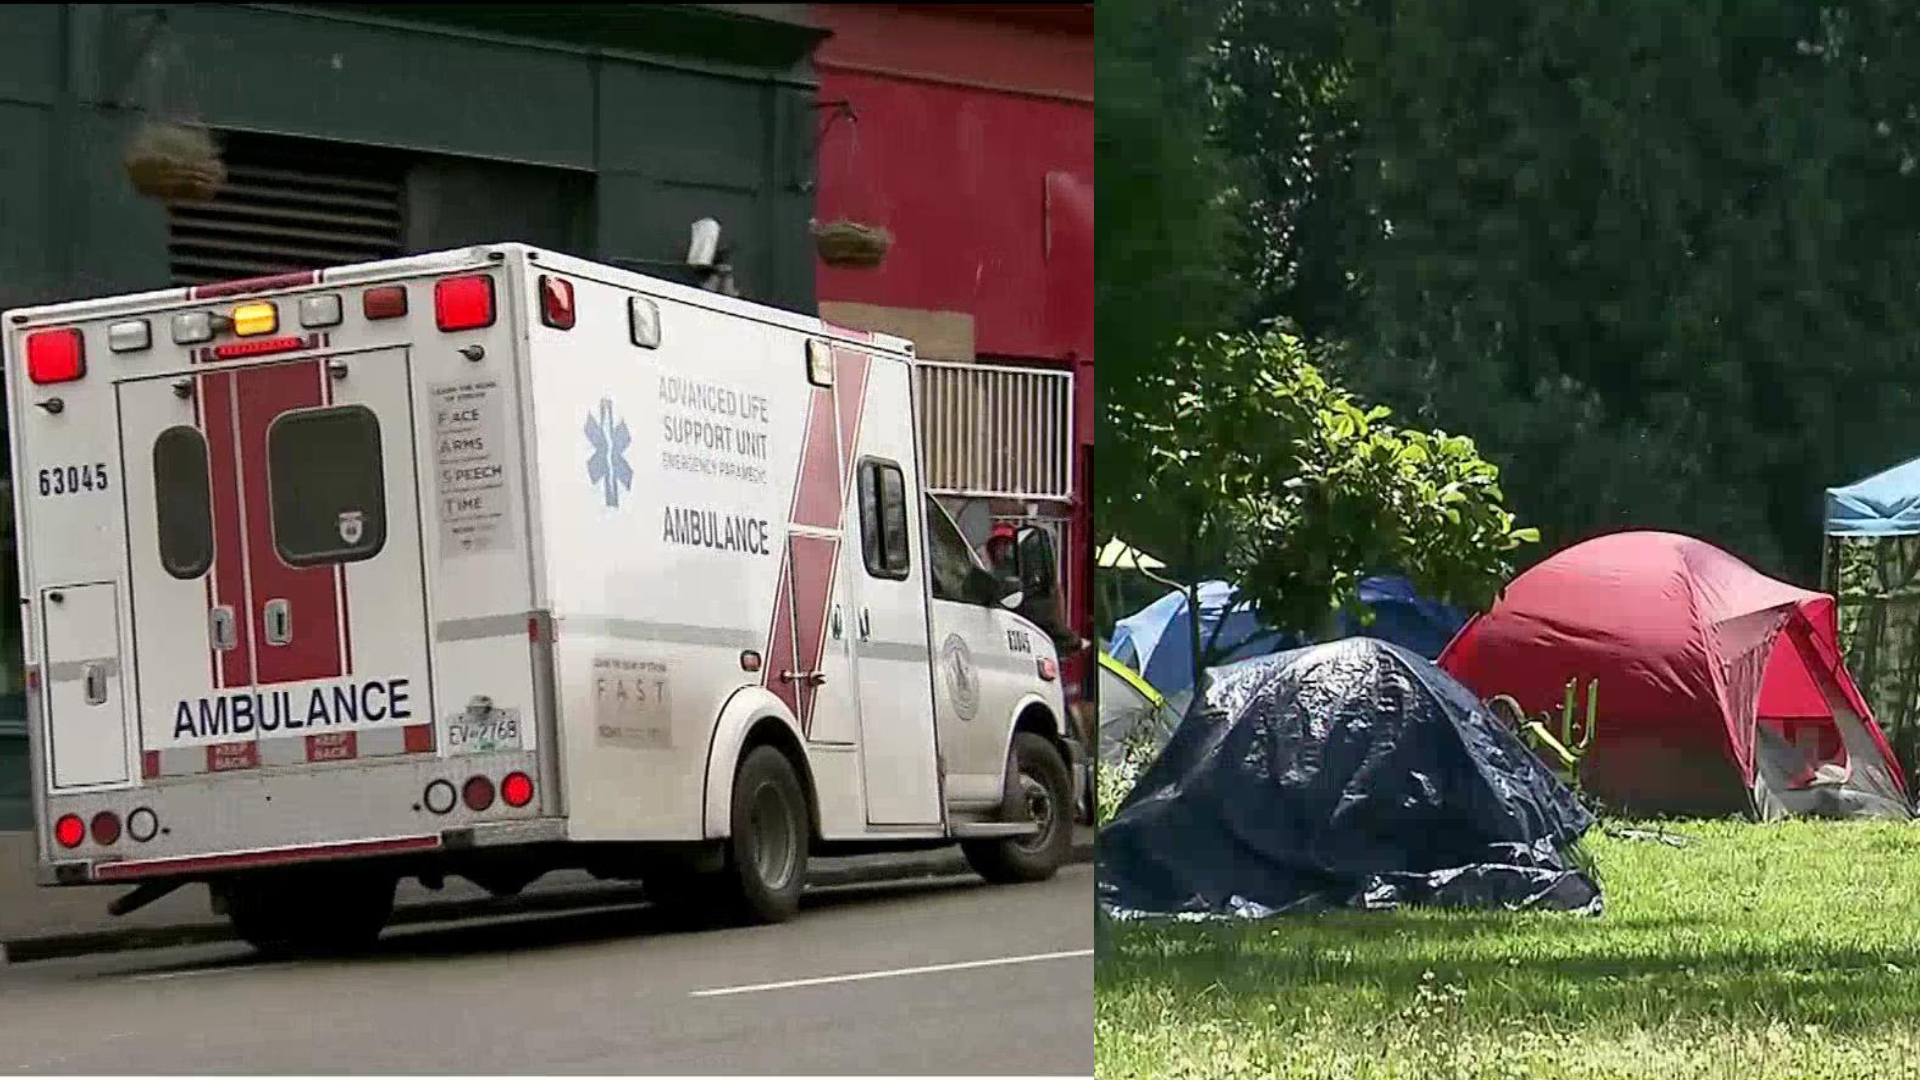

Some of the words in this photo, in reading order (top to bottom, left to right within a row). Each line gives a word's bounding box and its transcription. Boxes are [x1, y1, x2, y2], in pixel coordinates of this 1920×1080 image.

[659, 375, 737, 416] ADVANCED
[740, 393, 769, 423] LIFE
[440, 437, 484, 454] ARMS
[663, 415, 732, 450] SUPPORT
[736, 430, 768, 460] UNIT
[40, 463, 107, 496] 63045
[442, 465, 502, 483] SPEECH
[446, 497, 483, 514] TIME
[663, 506, 769, 556] AMBULANCE
[173, 679, 411, 740] AMBULANCE
